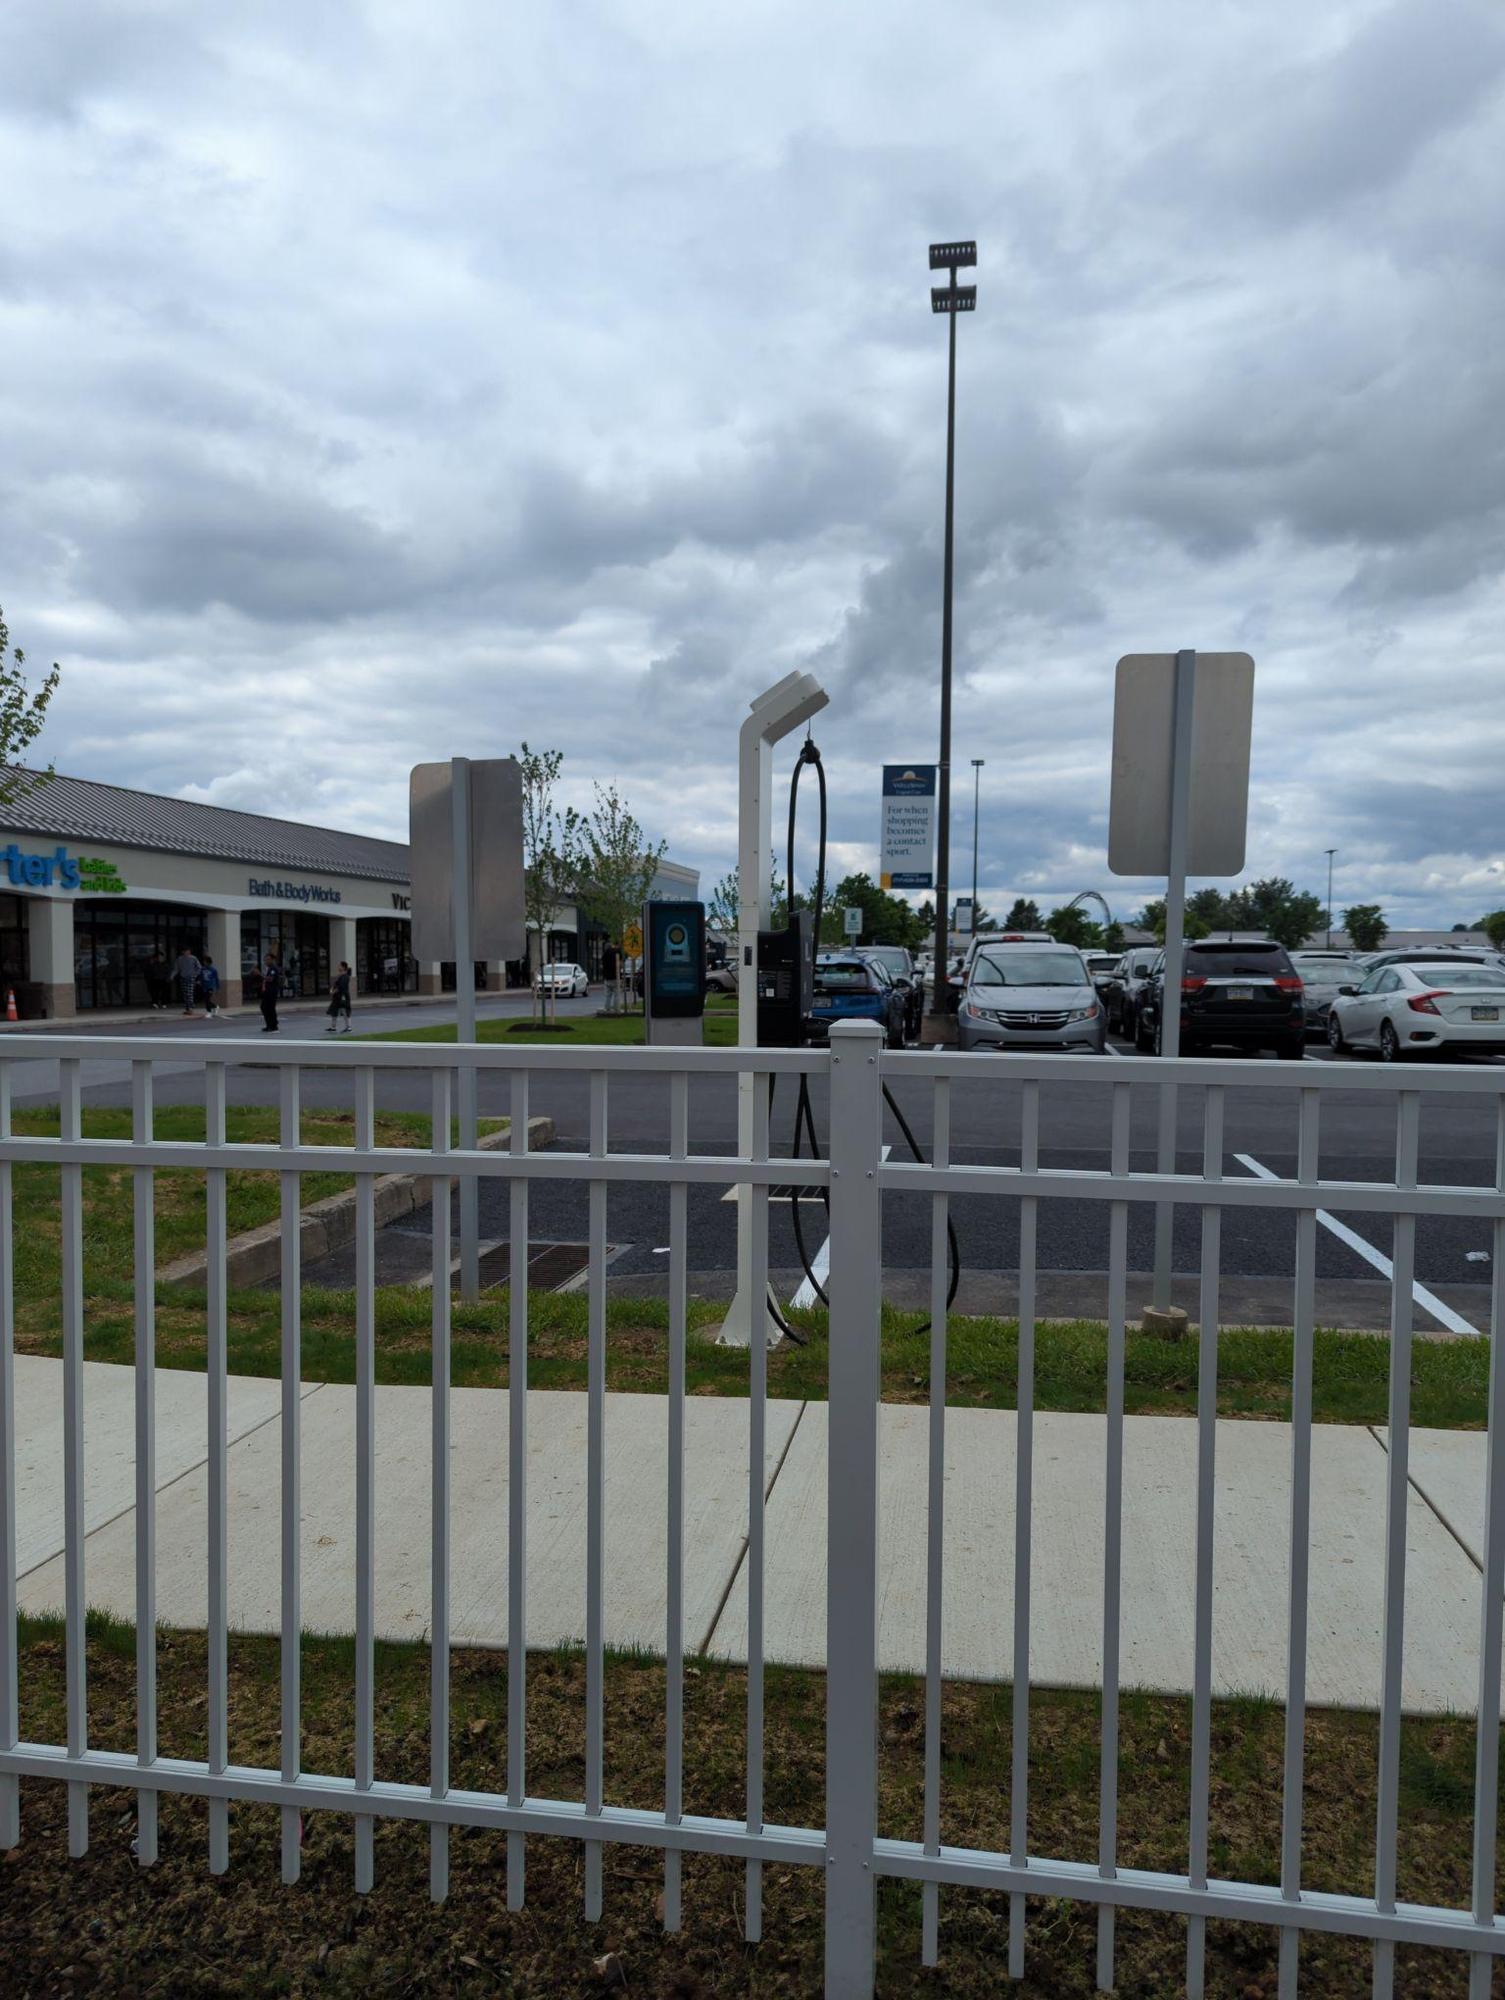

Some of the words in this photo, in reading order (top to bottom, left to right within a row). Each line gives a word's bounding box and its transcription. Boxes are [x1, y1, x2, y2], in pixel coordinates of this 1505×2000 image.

[888, 805, 902, 814] For
[904, 805, 928, 814] when
[888, 815, 928, 827] shopping
[887, 826, 926, 835] becomes
[249, 879, 275, 896] Bath
[276, 882, 283, 897] &
[285, 882, 310, 903] Body
[310, 885, 341, 904] Works
